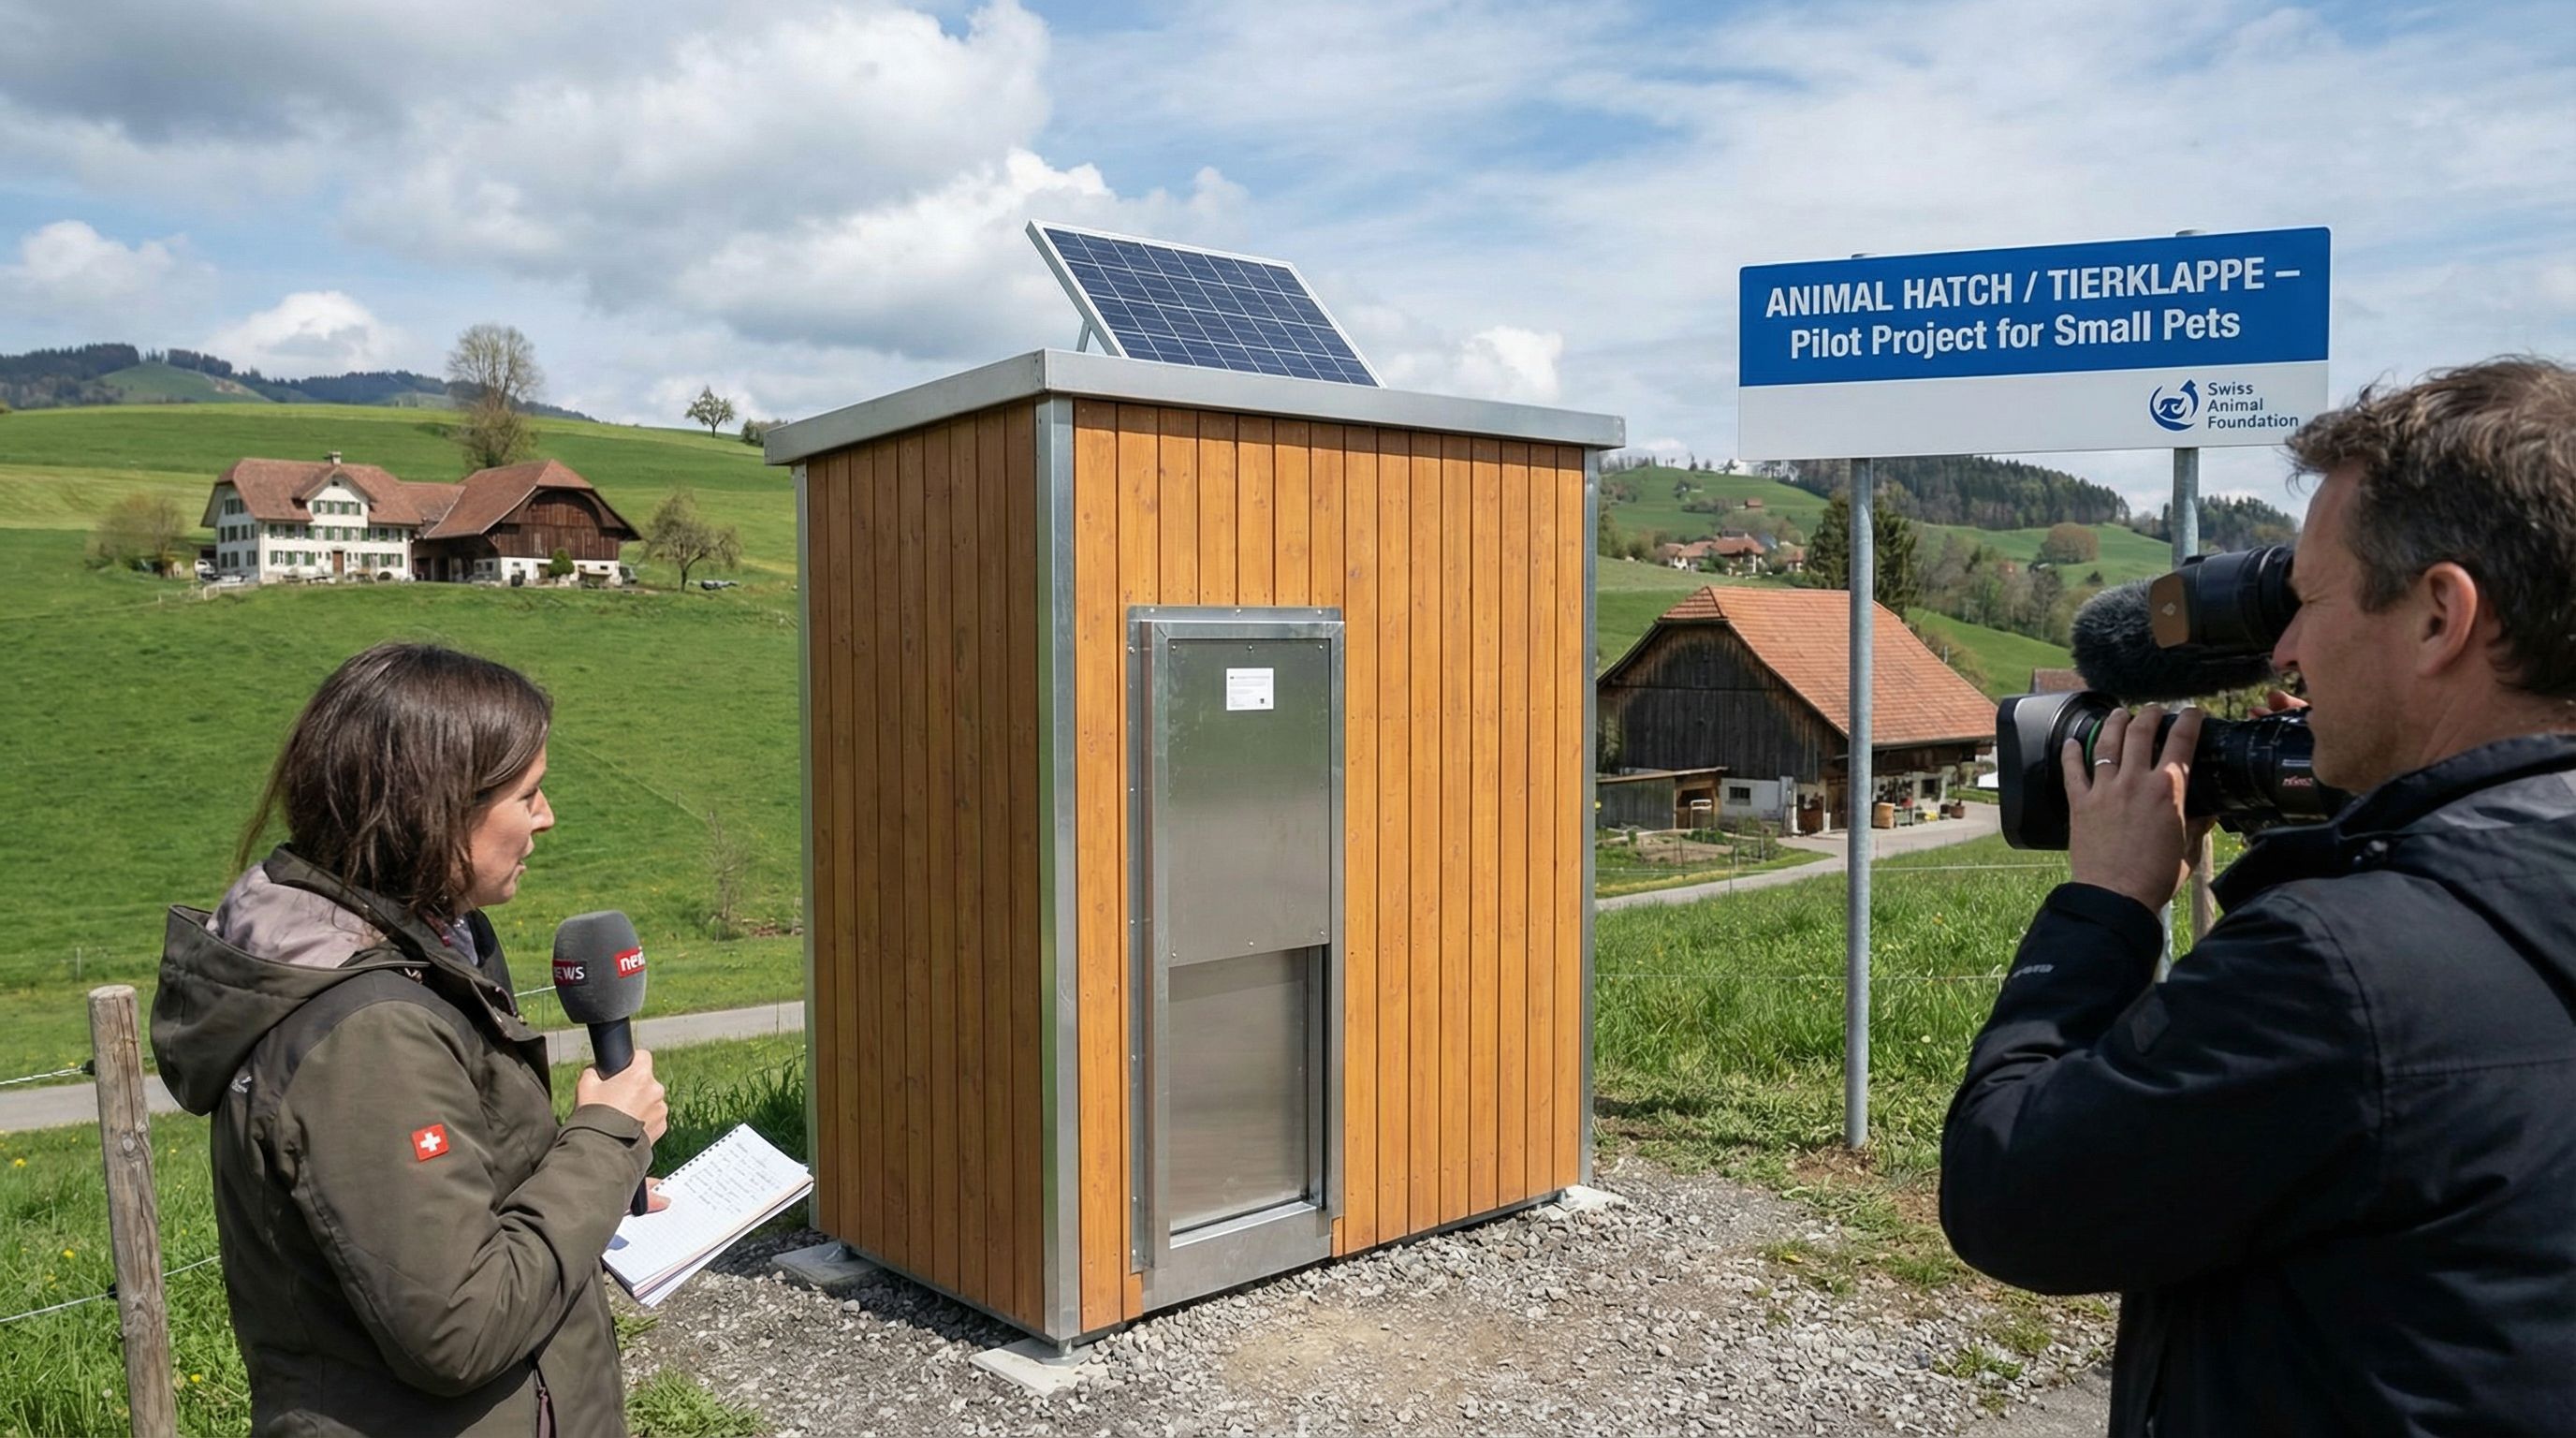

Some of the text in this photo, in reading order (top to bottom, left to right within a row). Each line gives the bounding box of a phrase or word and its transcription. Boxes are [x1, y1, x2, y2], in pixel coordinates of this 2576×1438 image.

[1765, 281, 1894, 318] ANIMAL
[1904, 272, 2012, 310] HATCH
[2023, 271, 2038, 303] /
[2047, 257, 2264, 301] TIERKLAPPE
[1791, 307, 2240, 360] Pilot Project for Small Pets
[2207, 381, 2254, 396] Swiss
[2206, 397, 2263, 413] Animal
[2207, 413, 2299, 429] Foundation
